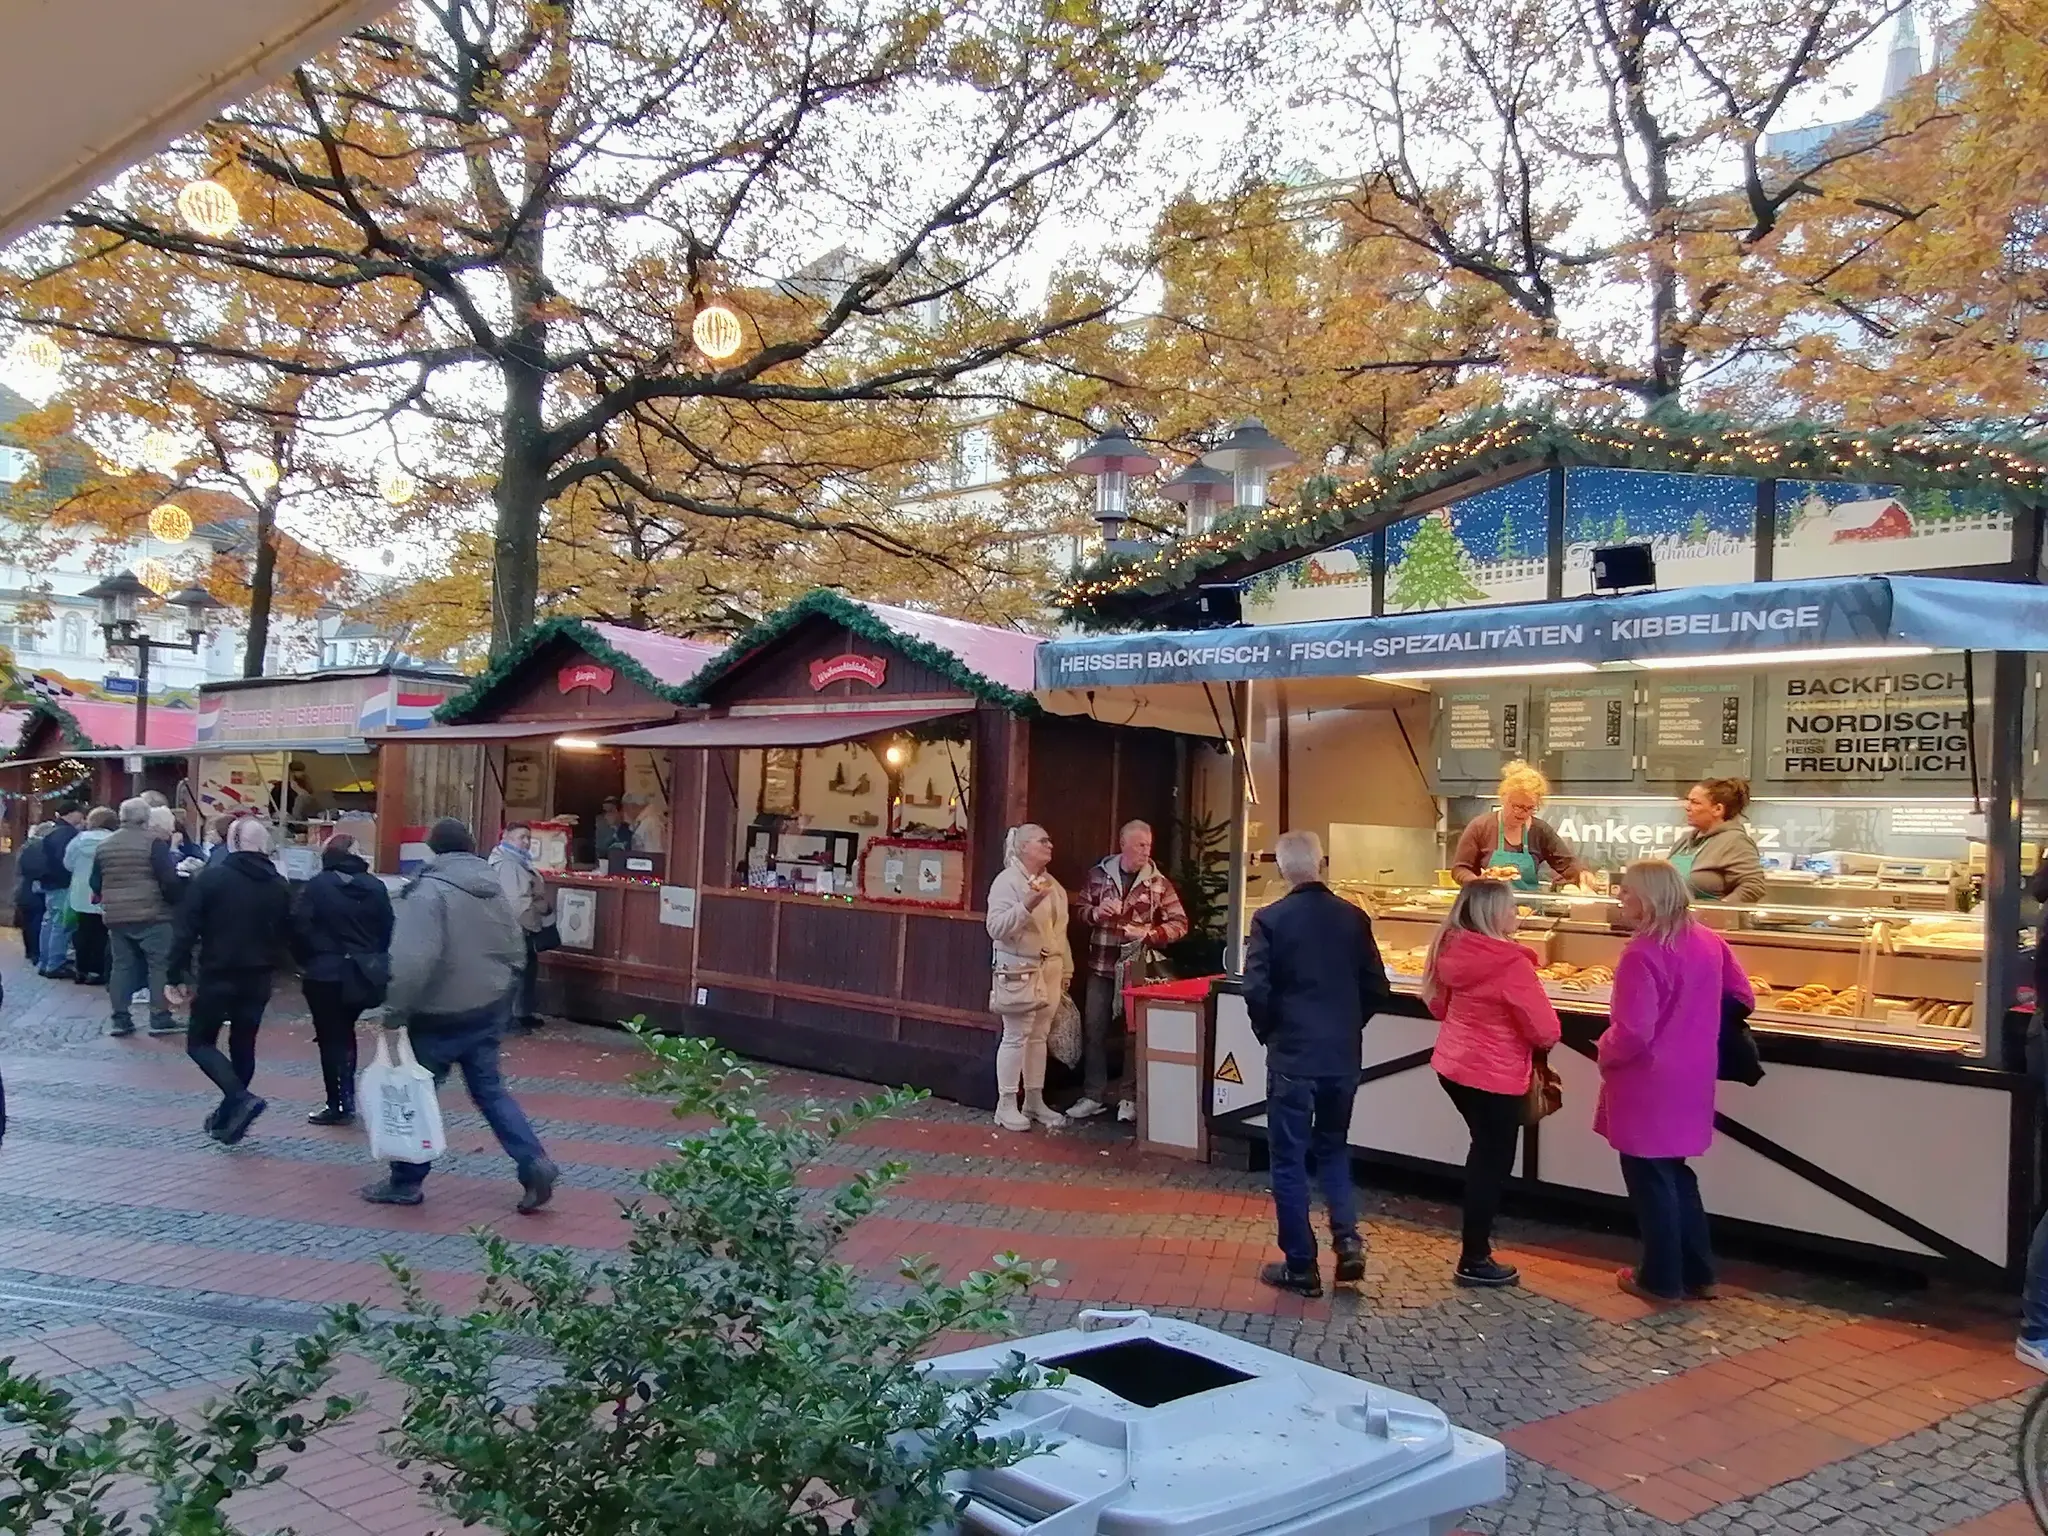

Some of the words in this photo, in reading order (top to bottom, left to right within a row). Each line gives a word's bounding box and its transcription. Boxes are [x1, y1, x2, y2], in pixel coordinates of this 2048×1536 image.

[1060, 655, 1143, 673] HEISSER
[1147, 645, 1270, 669] BACKFISCH
[1289, 624, 1584, 661] FISCH-SPEZIALITÄTEN
[1611, 605, 1820, 642] KIBBELINGE
[1787, 672, 1968, 696] BACKFISCH
[1786, 711, 1969, 734] NORDISCH
[1835, 735, 1968, 754] BIERTEIG
[1784, 755, 1966, 773] FREUNDLICH
